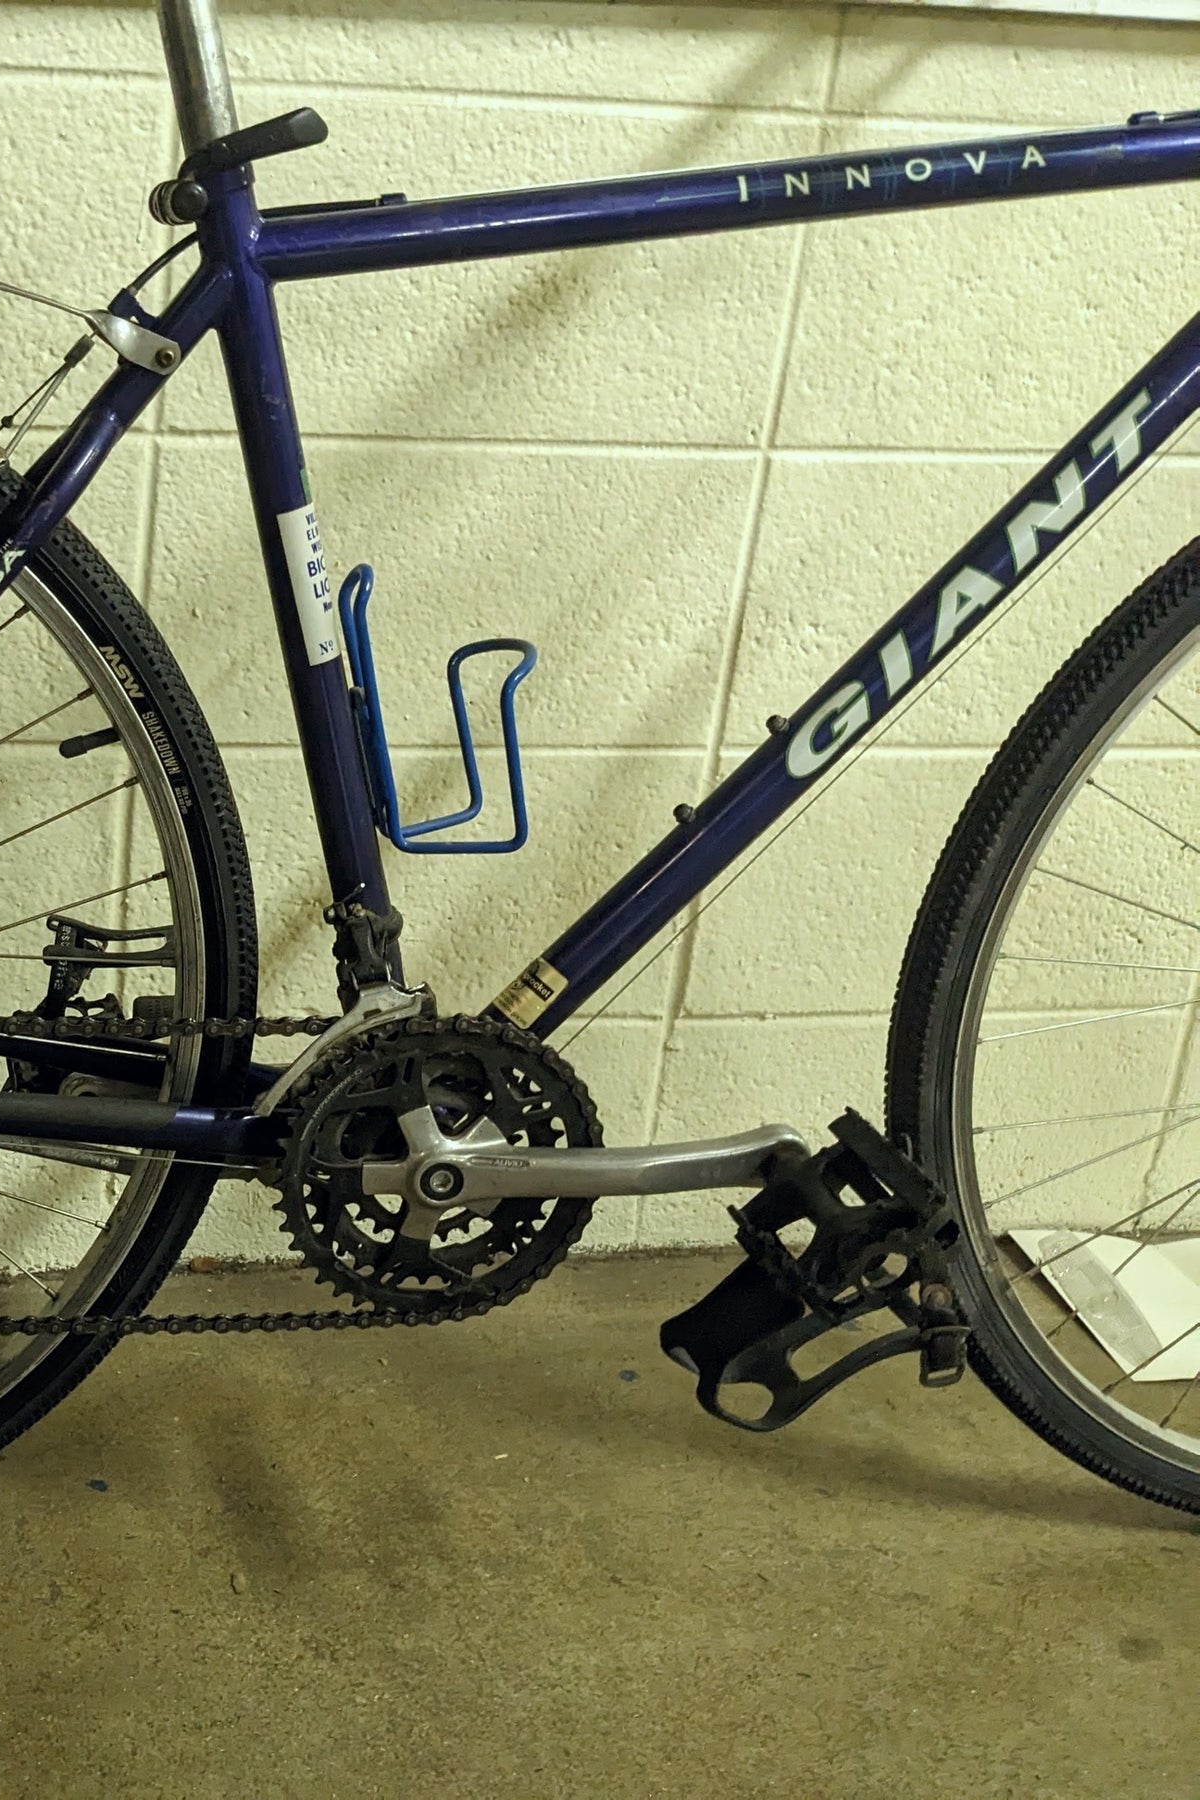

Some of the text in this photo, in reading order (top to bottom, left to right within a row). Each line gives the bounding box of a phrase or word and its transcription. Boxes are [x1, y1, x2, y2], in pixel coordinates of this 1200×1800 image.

[736, 145, 1046, 203] INNOVA
[0, 538, 14, 554] THE
[785, 388, 1152, 779] GIANT
[99, 645, 182, 775] MSW SHAKEDOWN
